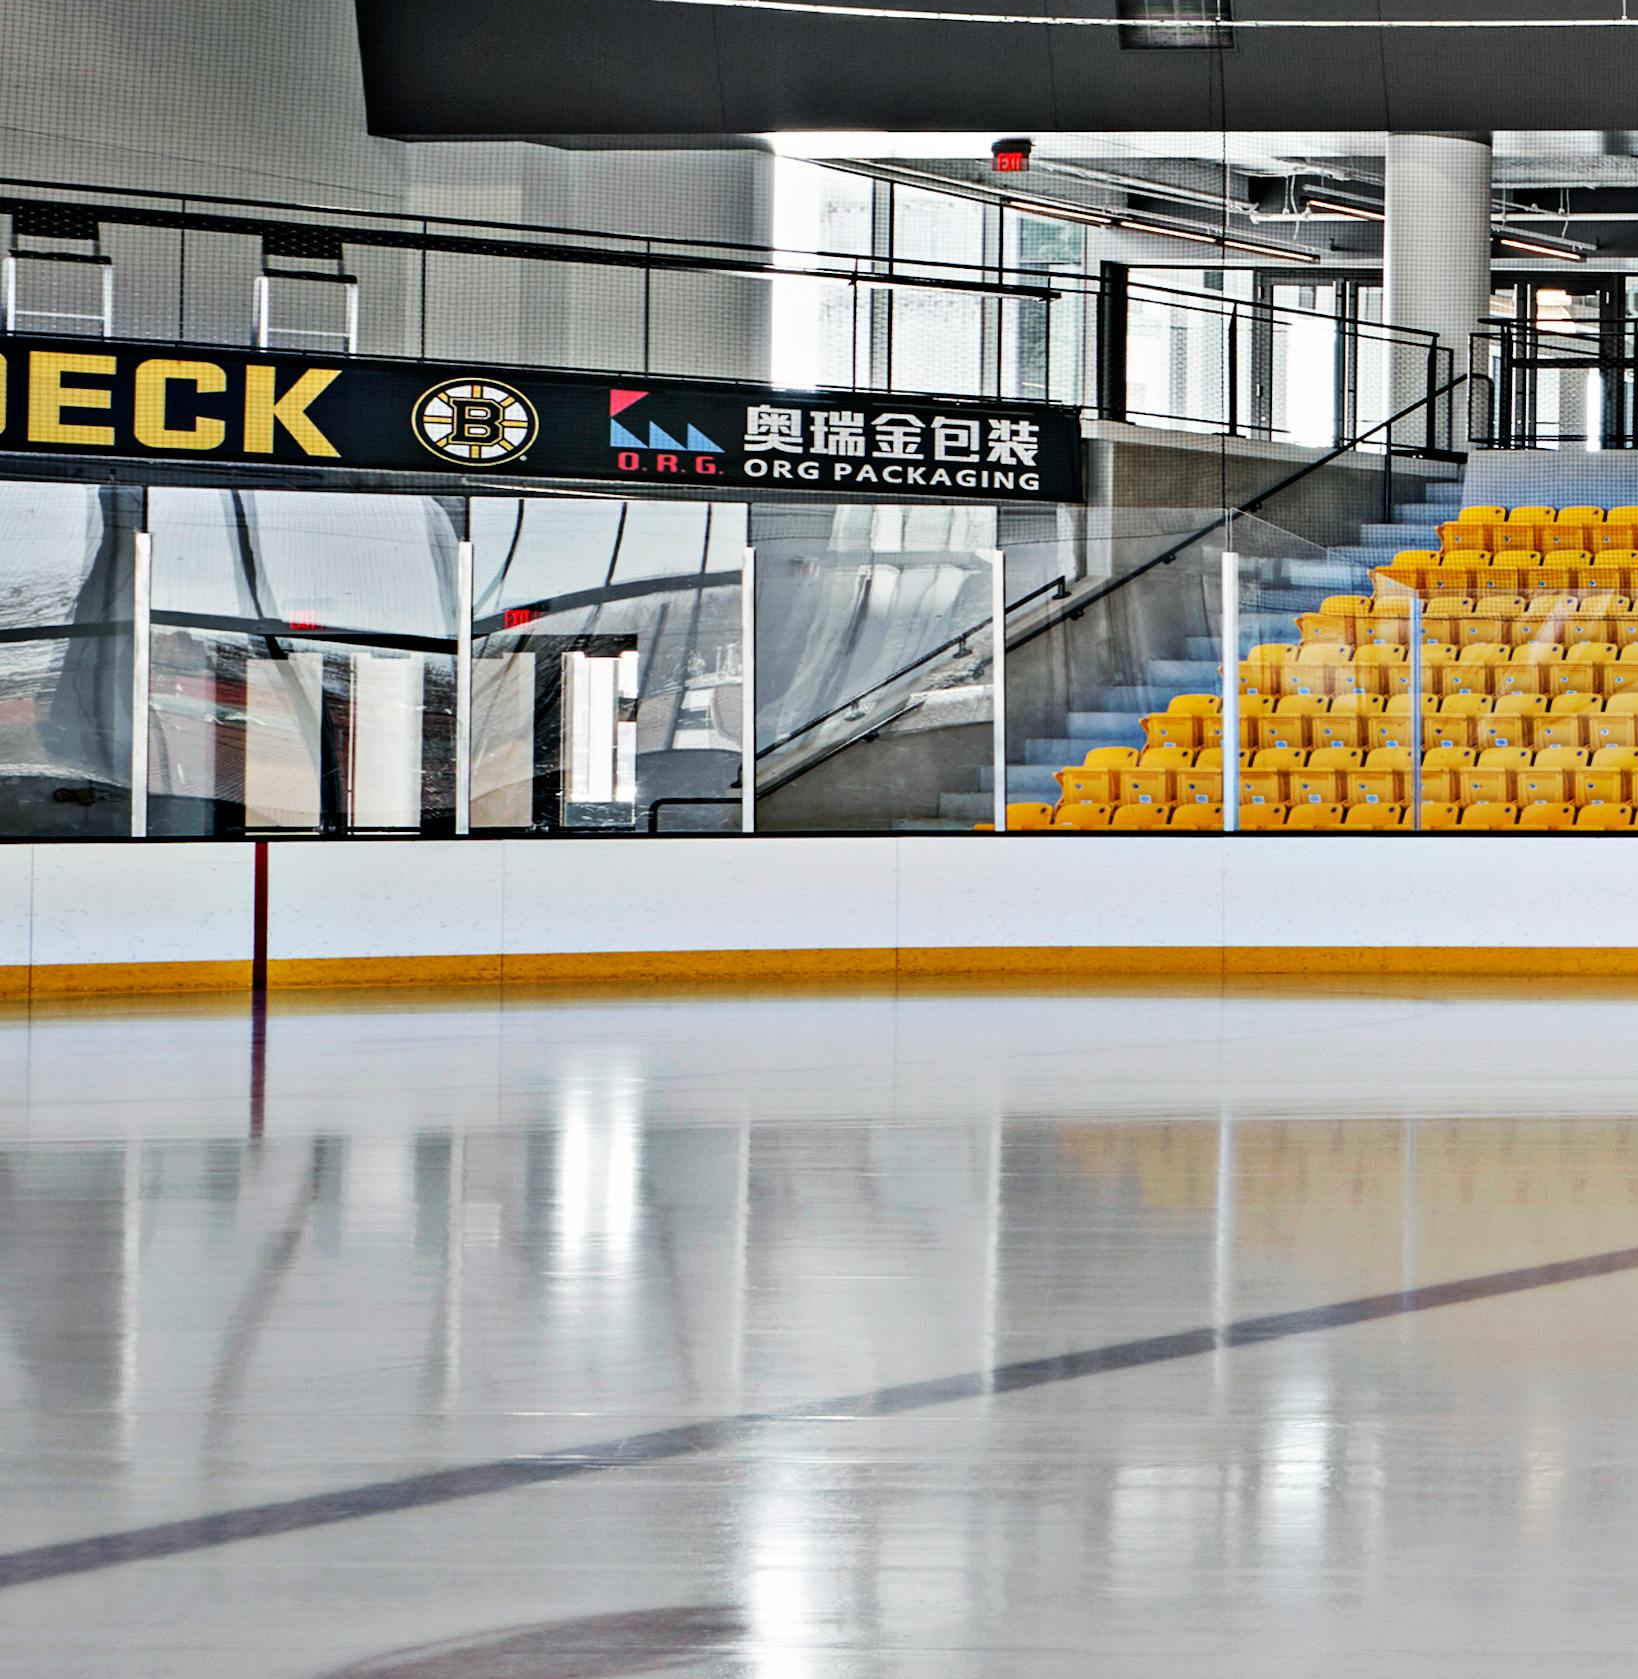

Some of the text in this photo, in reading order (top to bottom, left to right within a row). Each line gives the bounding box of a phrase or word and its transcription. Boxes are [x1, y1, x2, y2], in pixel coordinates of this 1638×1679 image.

[0, 351, 342, 458] ECK
[744, 404, 1039, 467] 奥瑞金包装
[744, 458, 1040, 491] ORG PACKAGING
